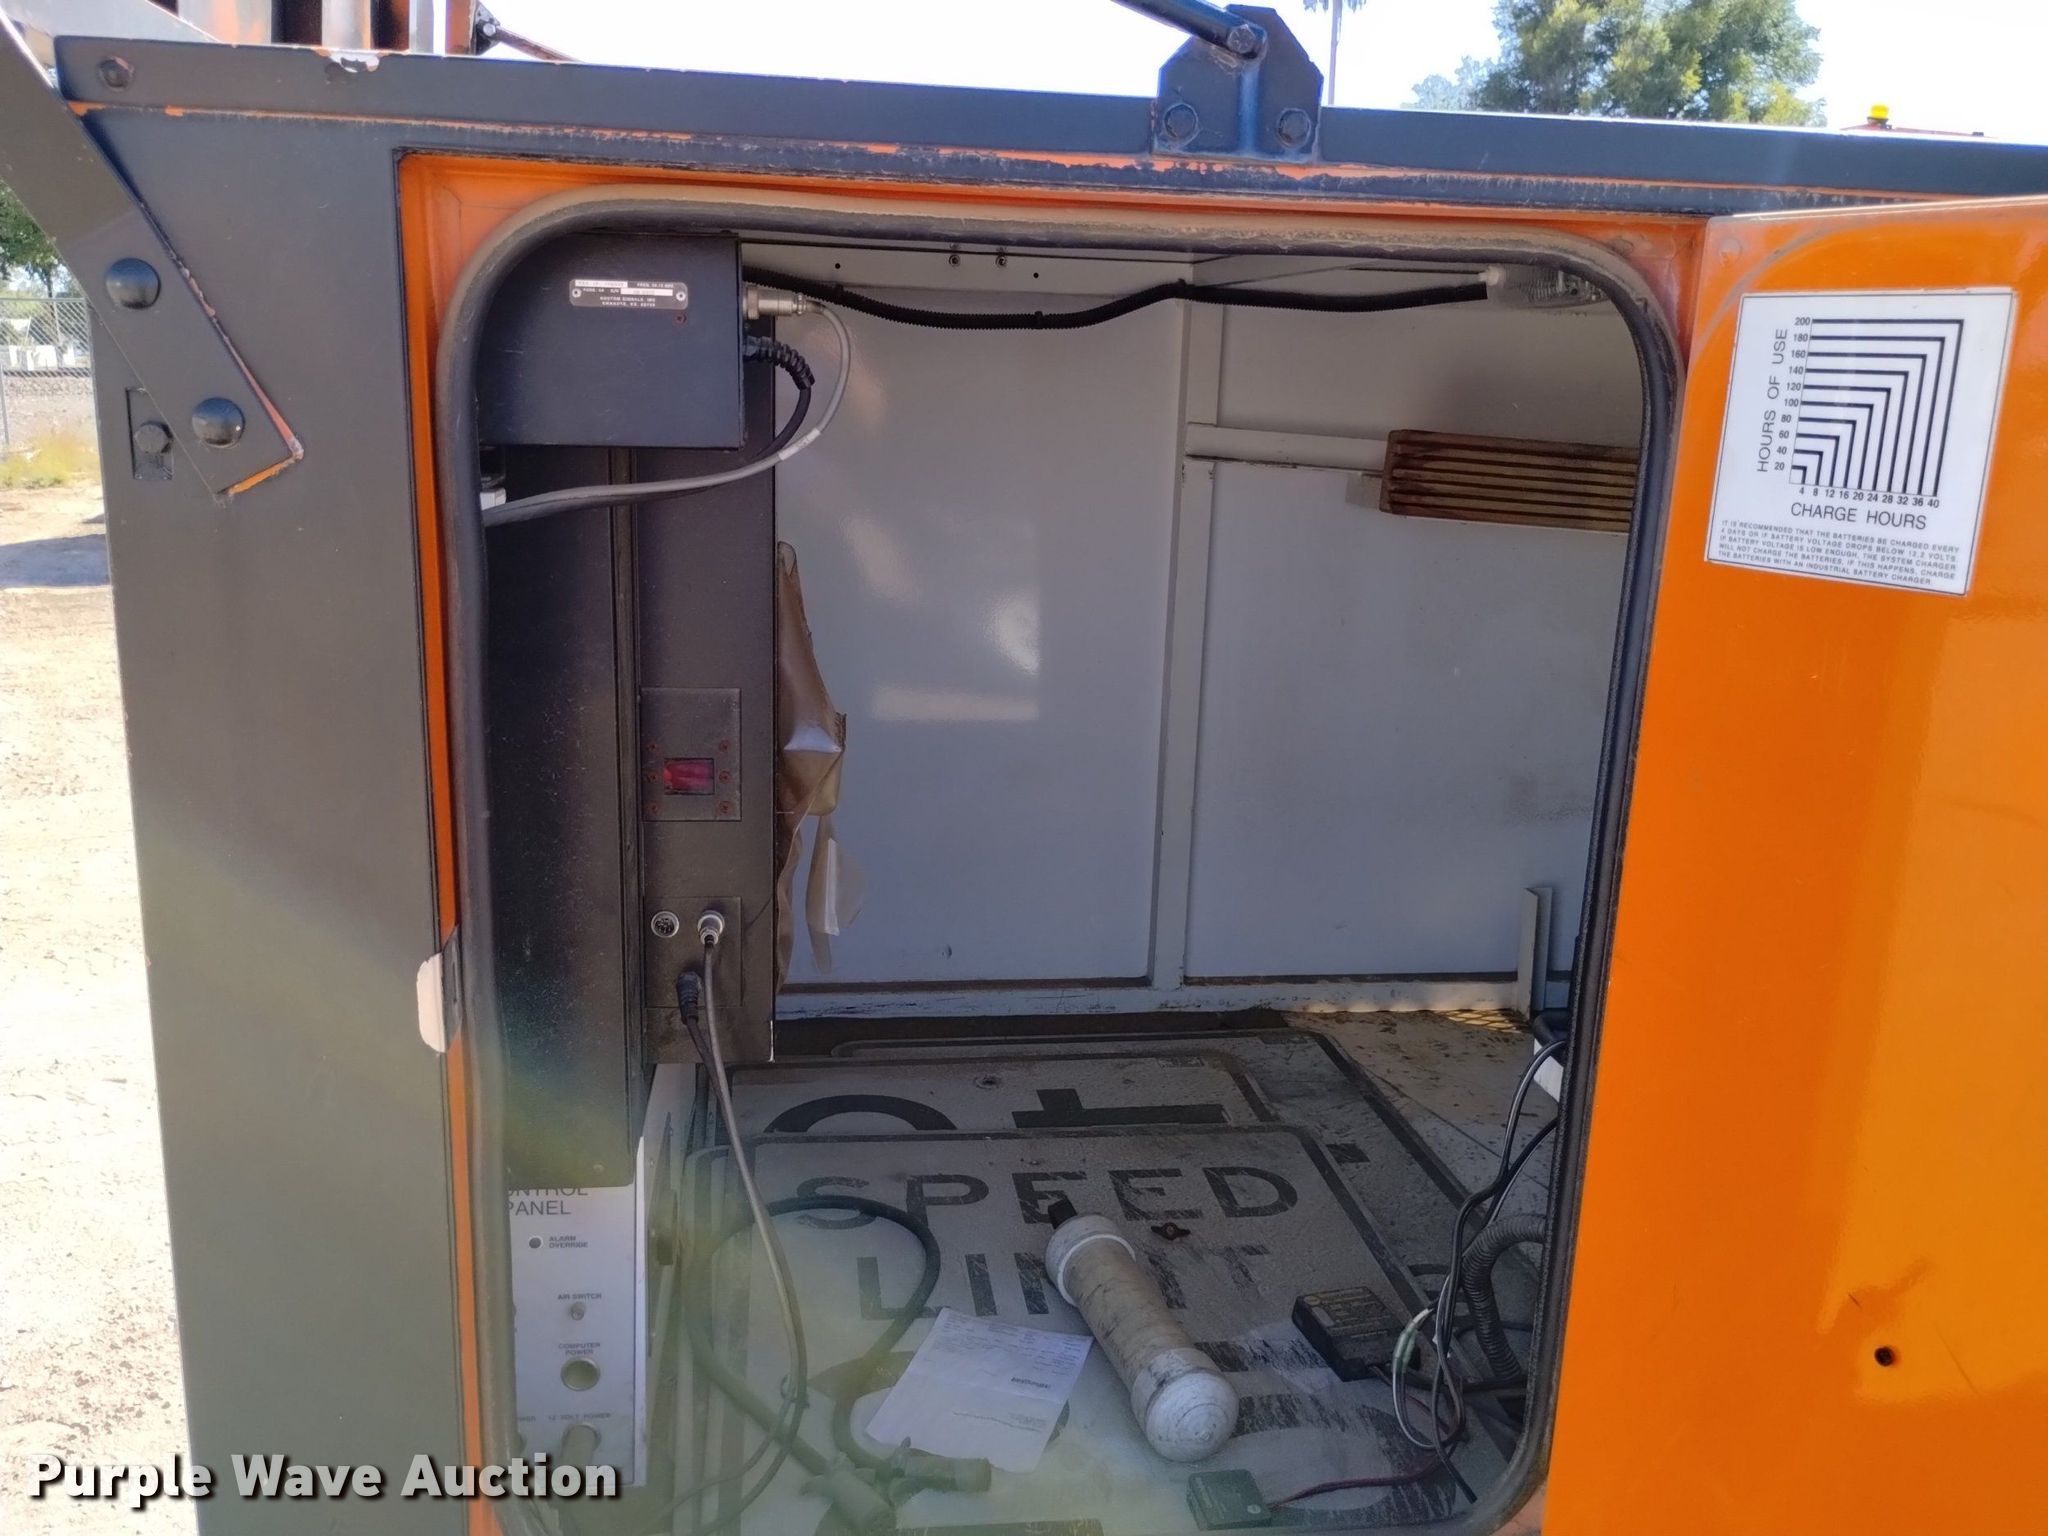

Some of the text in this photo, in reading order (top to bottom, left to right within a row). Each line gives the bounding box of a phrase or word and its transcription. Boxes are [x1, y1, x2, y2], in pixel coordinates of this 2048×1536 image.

[1794, 317, 1810, 325] 200
[1794, 333, 1808, 342] 180
[1789, 366, 1803, 374] 140
[1787, 382, 1801, 391] 120
[1757, 329, 1787, 472] HOURS OF USE
[1785, 399, 1798, 407] 100
[1781, 415, 1791, 423] 80
[1779, 430, 1789, 439] 60
[1777, 446, 1787, 455] 40
[1774, 462, 1784, 470] 20
[1825, 489, 1835, 498] 12
[1840, 491, 1849, 499] 16
[1853, 492, 1864, 500] 20
[1867, 493, 1878, 502] 24
[1882, 495, 1893, 503] 28
[1897, 496, 1908, 505] 32
[1912, 497, 1923, 506] 36
[1928, 499, 1939, 508] 40
[1791, 502, 1926, 530] CHARGE HOURS
[1739, 522, 1793, 534] RECOMMENDED
[1833, 532, 1874, 543] BATTERIES
[1890, 539, 1929, 549] CHARGED
[1771, 534, 1804, 543] BATTERY
[1807, 538, 1842, 546] VOLTAGE
[1762, 541, 1794, 550] VOLTAGE
[1881, 555, 1912, 565] SYSTEM
[1916, 560, 1956, 570] CHARGER
[1733, 552, 1770, 563] BATTERIES
[1806, 562, 1850, 574] INDUSTRIAL
[1854, 569, 1888, 579] BATTERY
[1753, 547, 1781, 556] CHARGE
[1920, 569, 1955, 579] CHARGE
[796, 1166, 1298, 1229] SPEED
